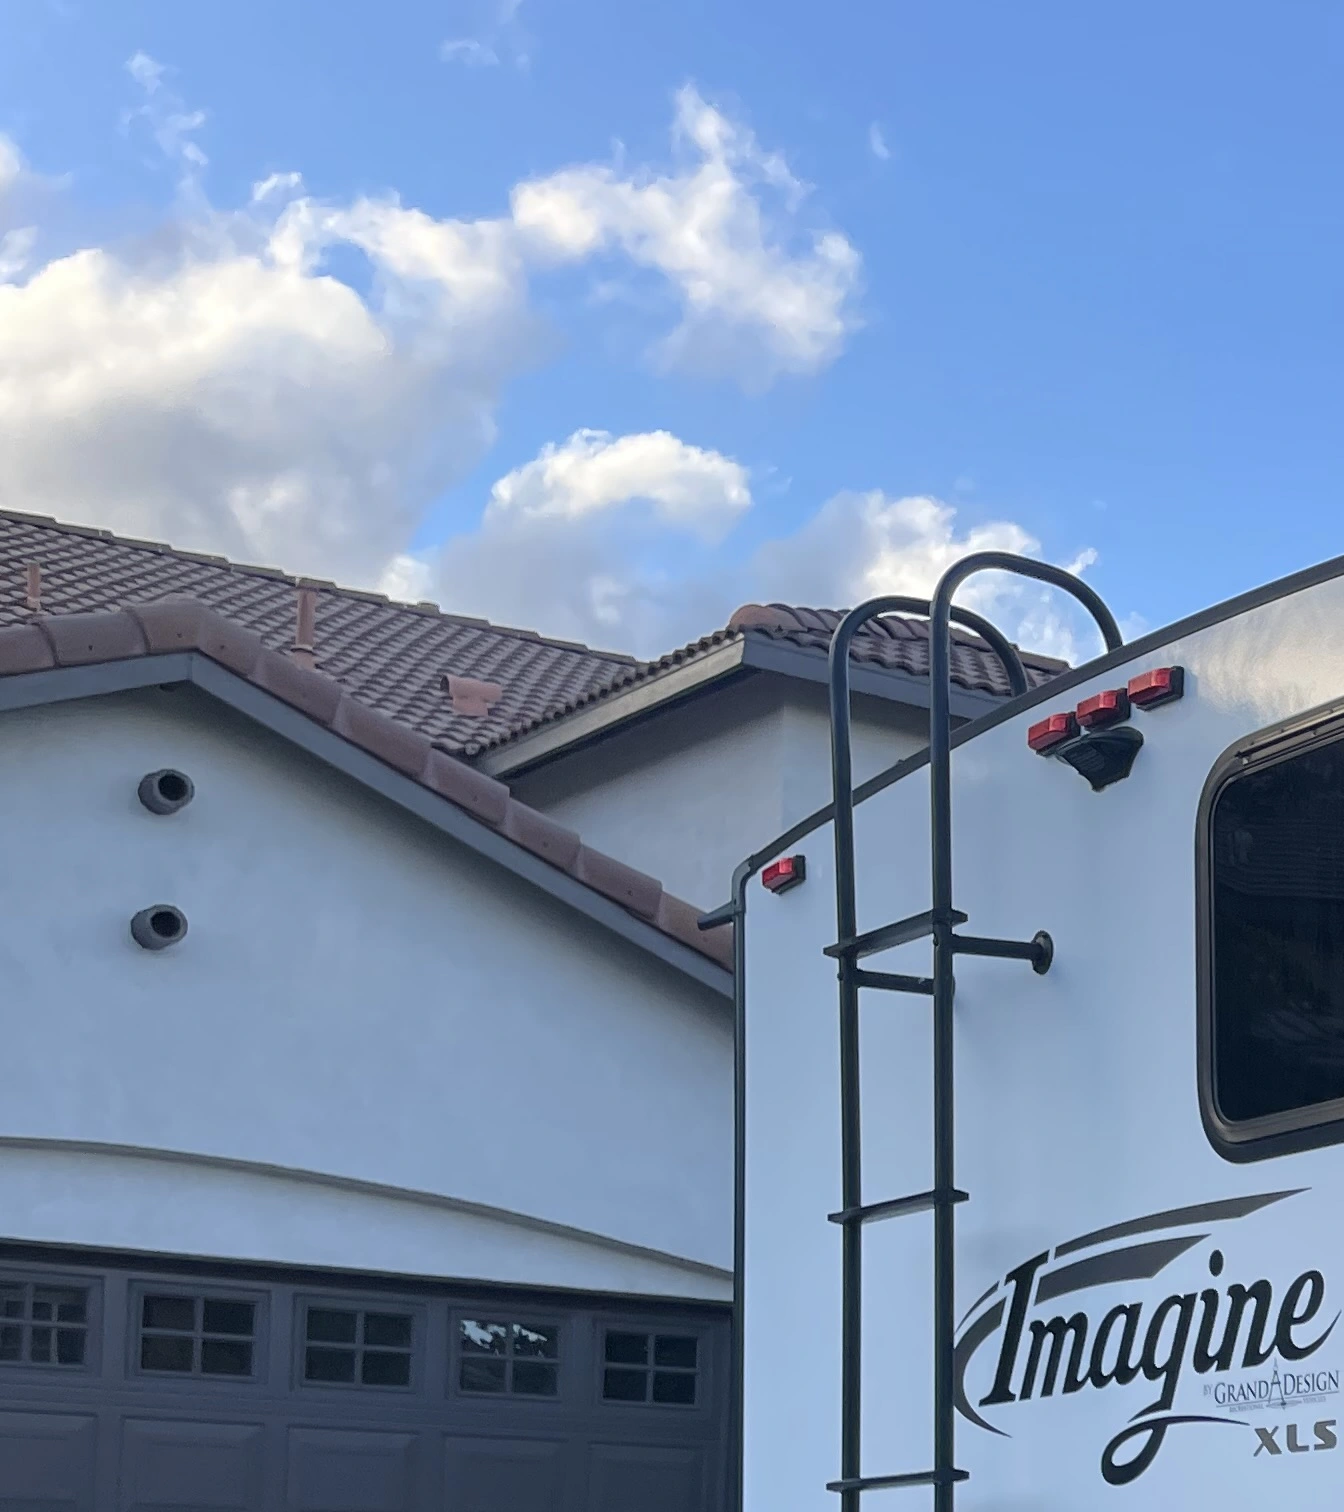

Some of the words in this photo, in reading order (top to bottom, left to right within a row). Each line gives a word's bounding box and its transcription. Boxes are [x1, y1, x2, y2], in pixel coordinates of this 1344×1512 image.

[978, 1249, 1342, 1486] Imagine
[1214, 1380, 1269, 1405] GRAND
[1283, 1369, 1340, 1396] DESIGN
[1253, 1419, 1337, 1457] XLS
